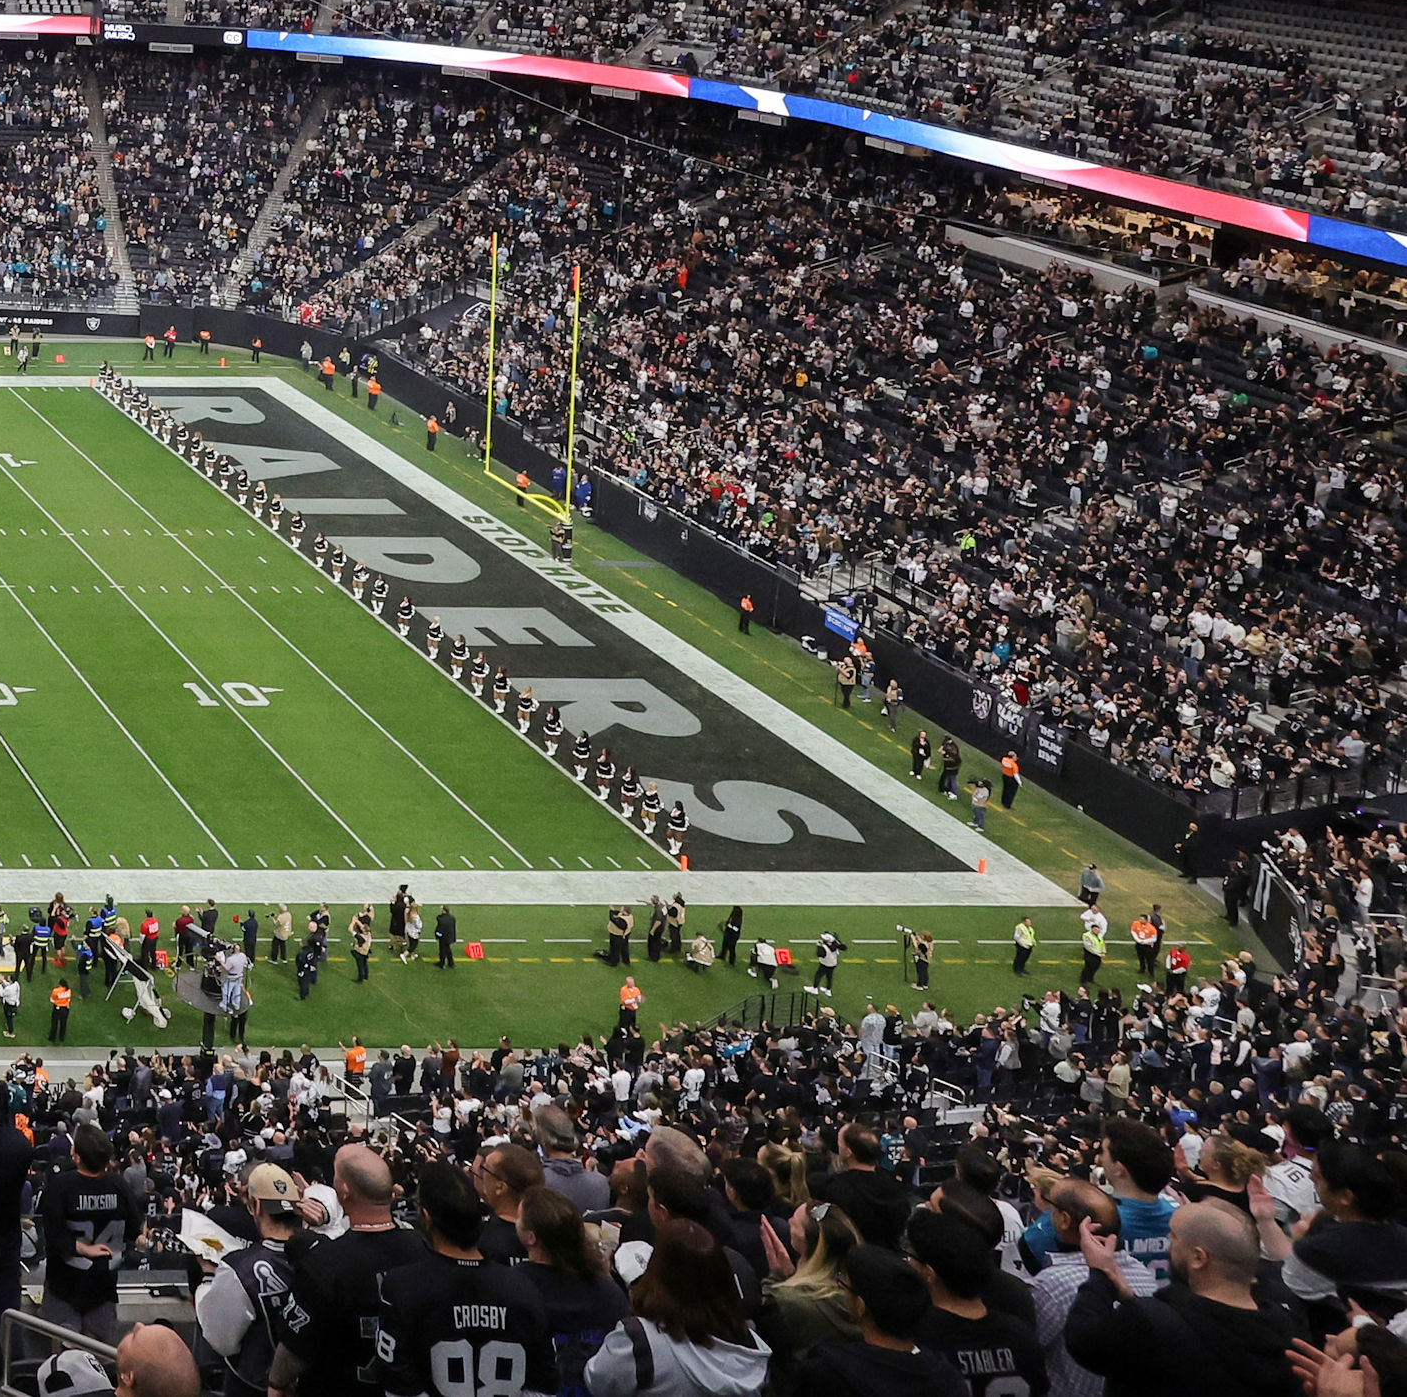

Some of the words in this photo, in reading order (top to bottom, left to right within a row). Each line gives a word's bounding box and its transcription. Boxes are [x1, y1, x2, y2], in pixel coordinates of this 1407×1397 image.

[103, 23, 133, 32] MUSIC)
[103, 30, 136, 41] (MUSIC)
[225, 33, 240, 42] CC
[23, 317, 53, 327] RAIDERS
[462, 514, 547, 562] STOP
[541, 565, 636, 615] HATE
[138, 395, 867, 846] RAIDERS
[183, 681, 271, 708] 10
[1282, 1166, 1305, 1184] 16
[75, 1193, 119, 1212] JACKSON
[453, 1304, 507, 1332] CROSBY
[430, 1339, 527, 1396] 98
[956, 1346, 1016, 1376] STABLER
